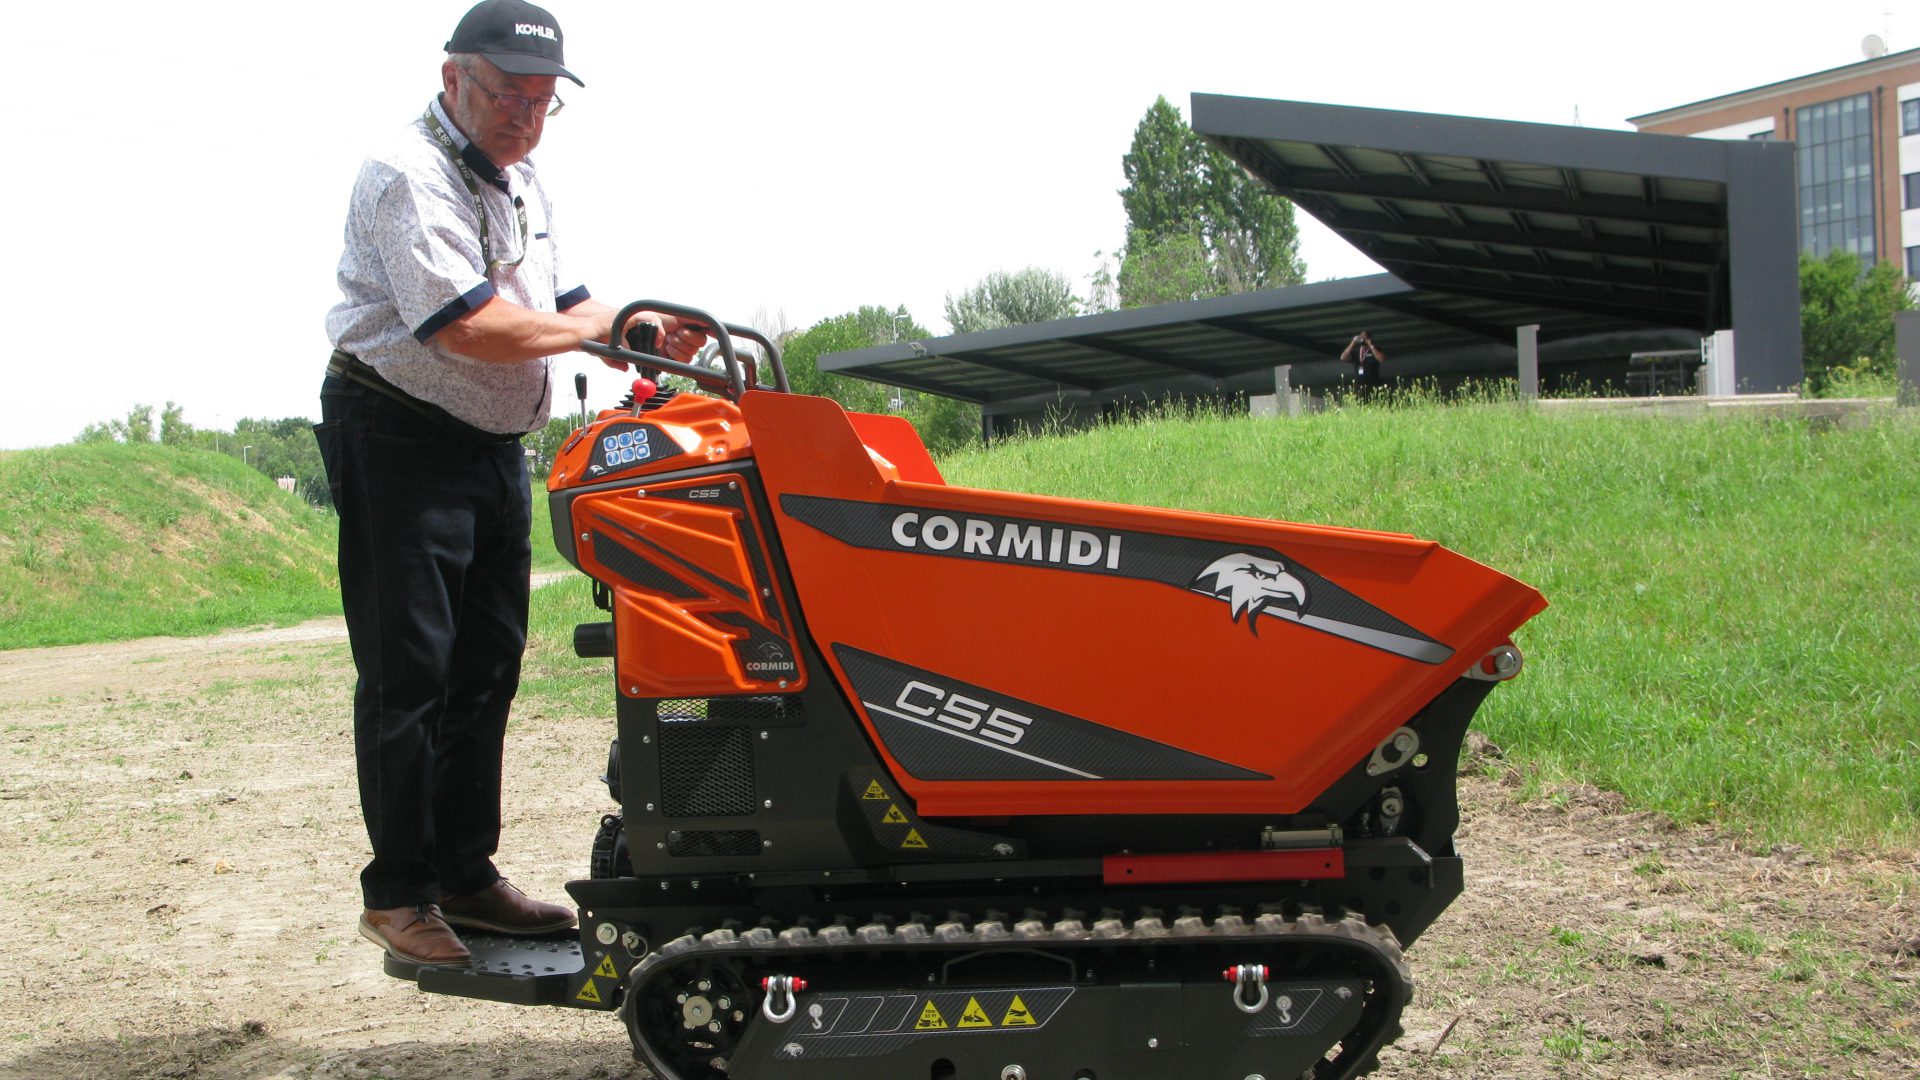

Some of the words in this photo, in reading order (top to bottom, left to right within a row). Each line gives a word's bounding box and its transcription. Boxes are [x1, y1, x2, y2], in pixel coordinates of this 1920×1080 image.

[689, 489, 720, 498] C55
[891, 512, 1122, 570] CORMIDI
[746, 661, 794, 671] CORMIDI
[895, 680, 1034, 745] C55
